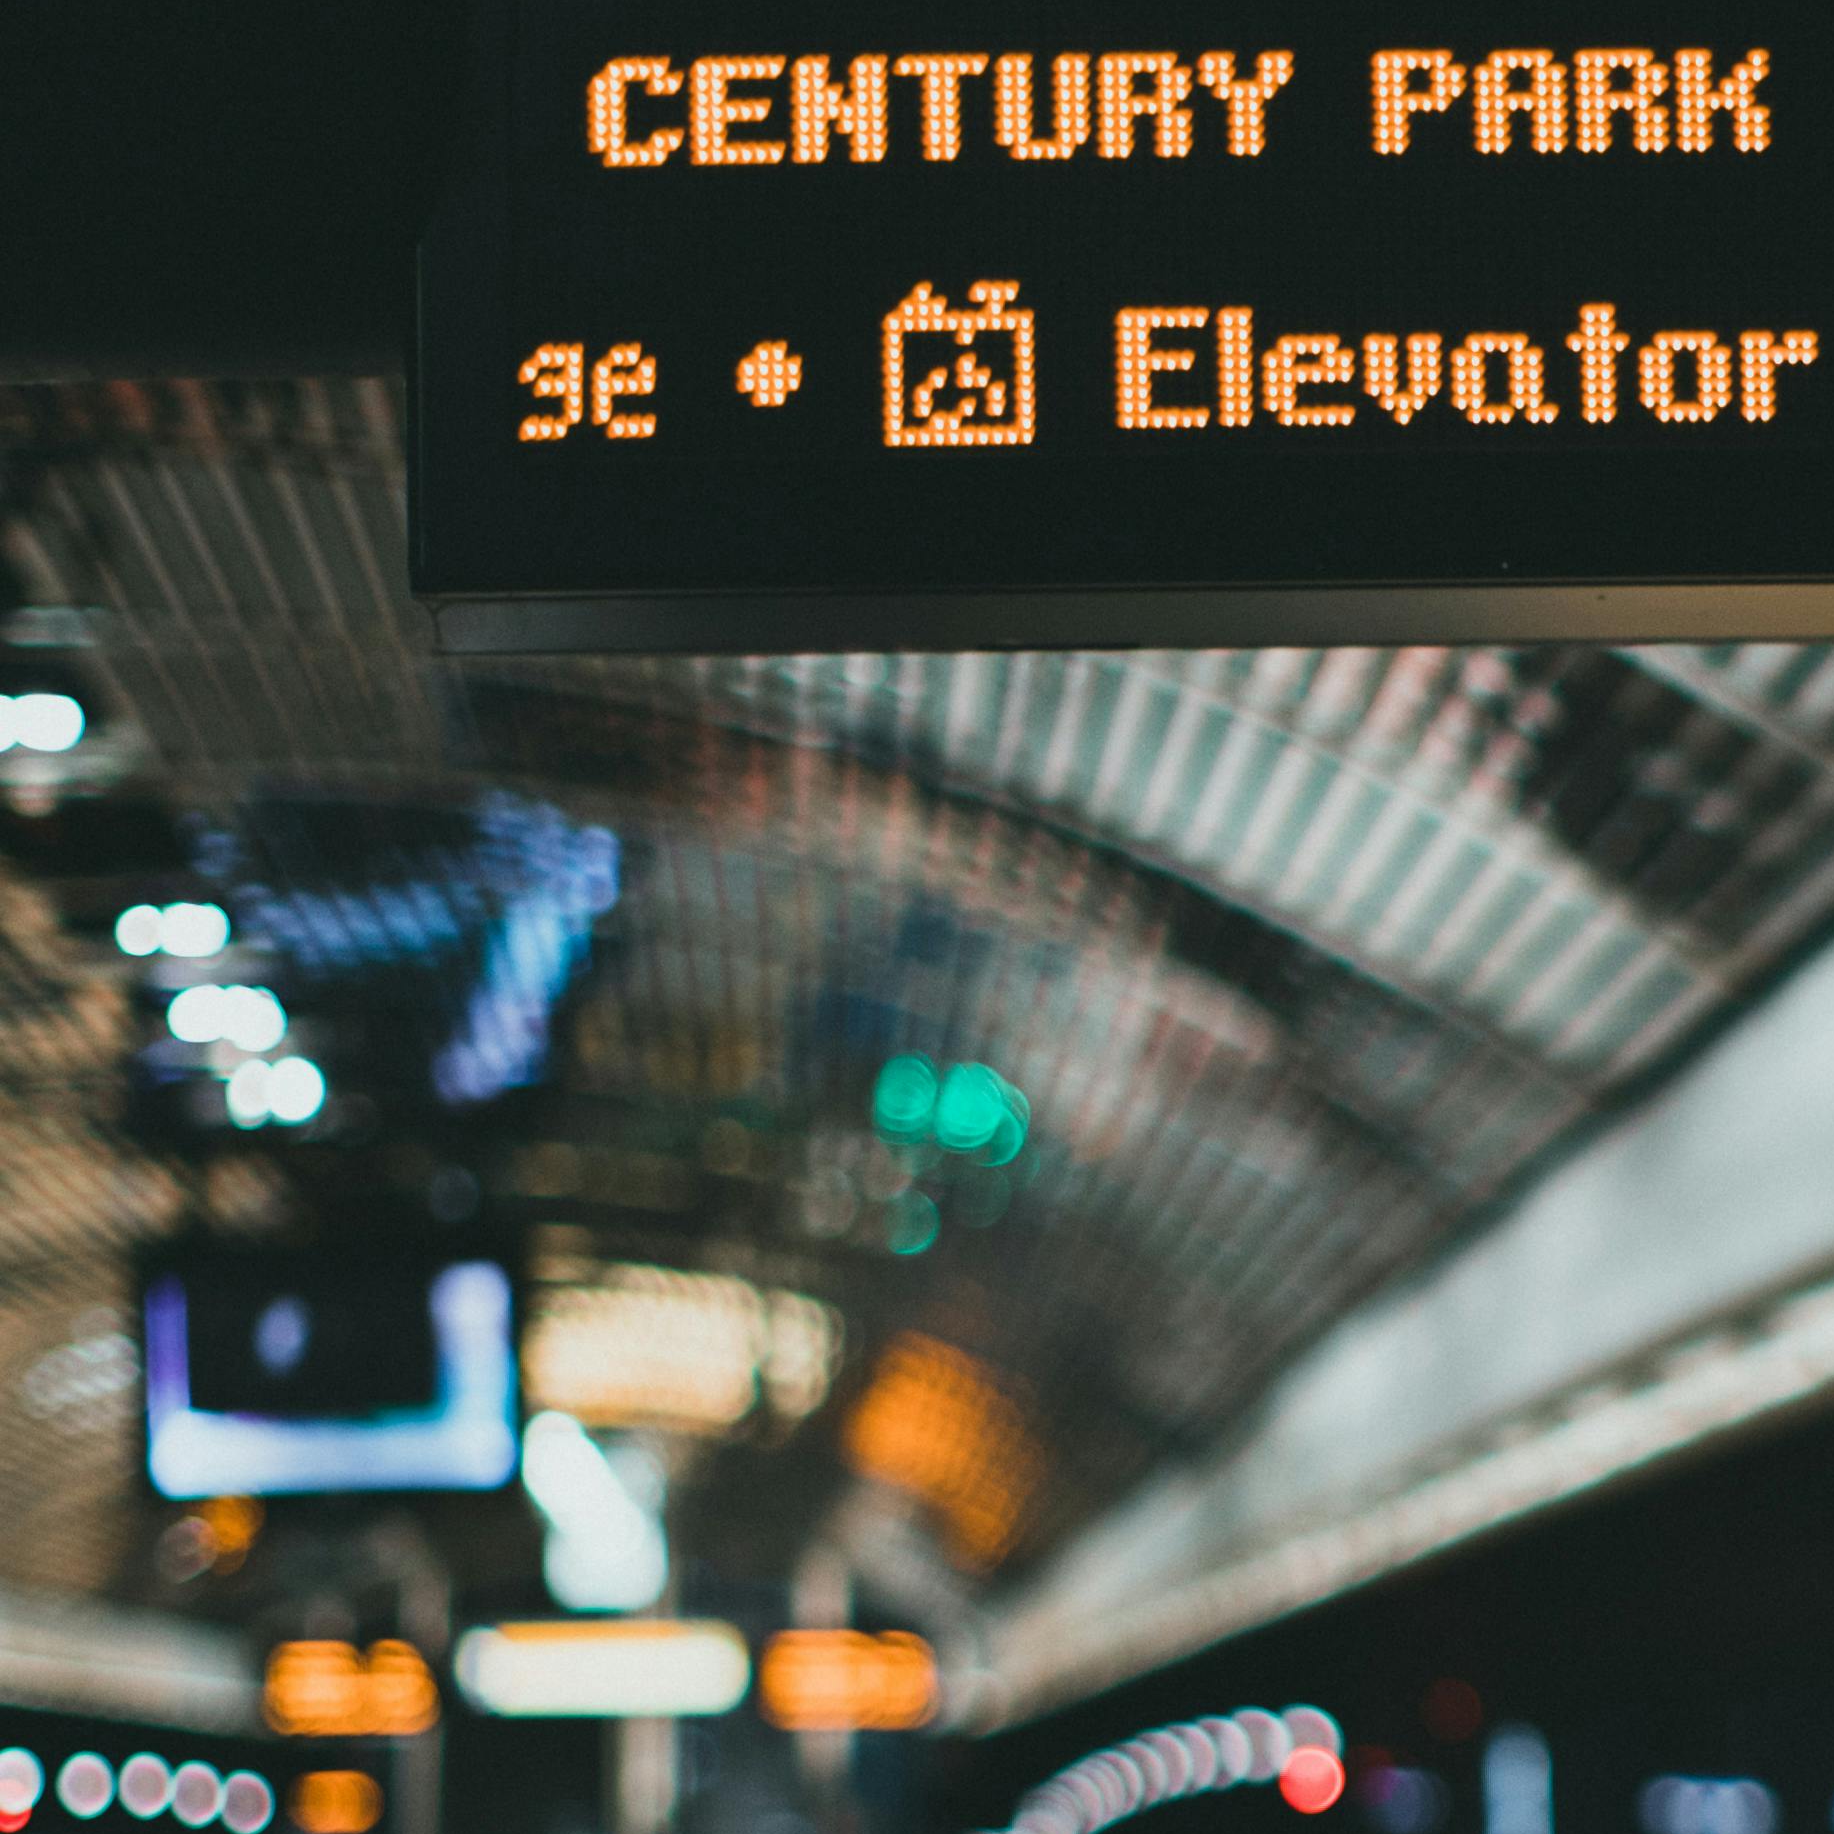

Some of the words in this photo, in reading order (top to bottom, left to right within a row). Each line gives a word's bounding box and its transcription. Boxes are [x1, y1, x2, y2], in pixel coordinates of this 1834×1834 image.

[587, 50, 1294, 167] CENTURY
[1371, 48, 1771, 155] PARK
[1115, 303, 1818, 429] Elevator
